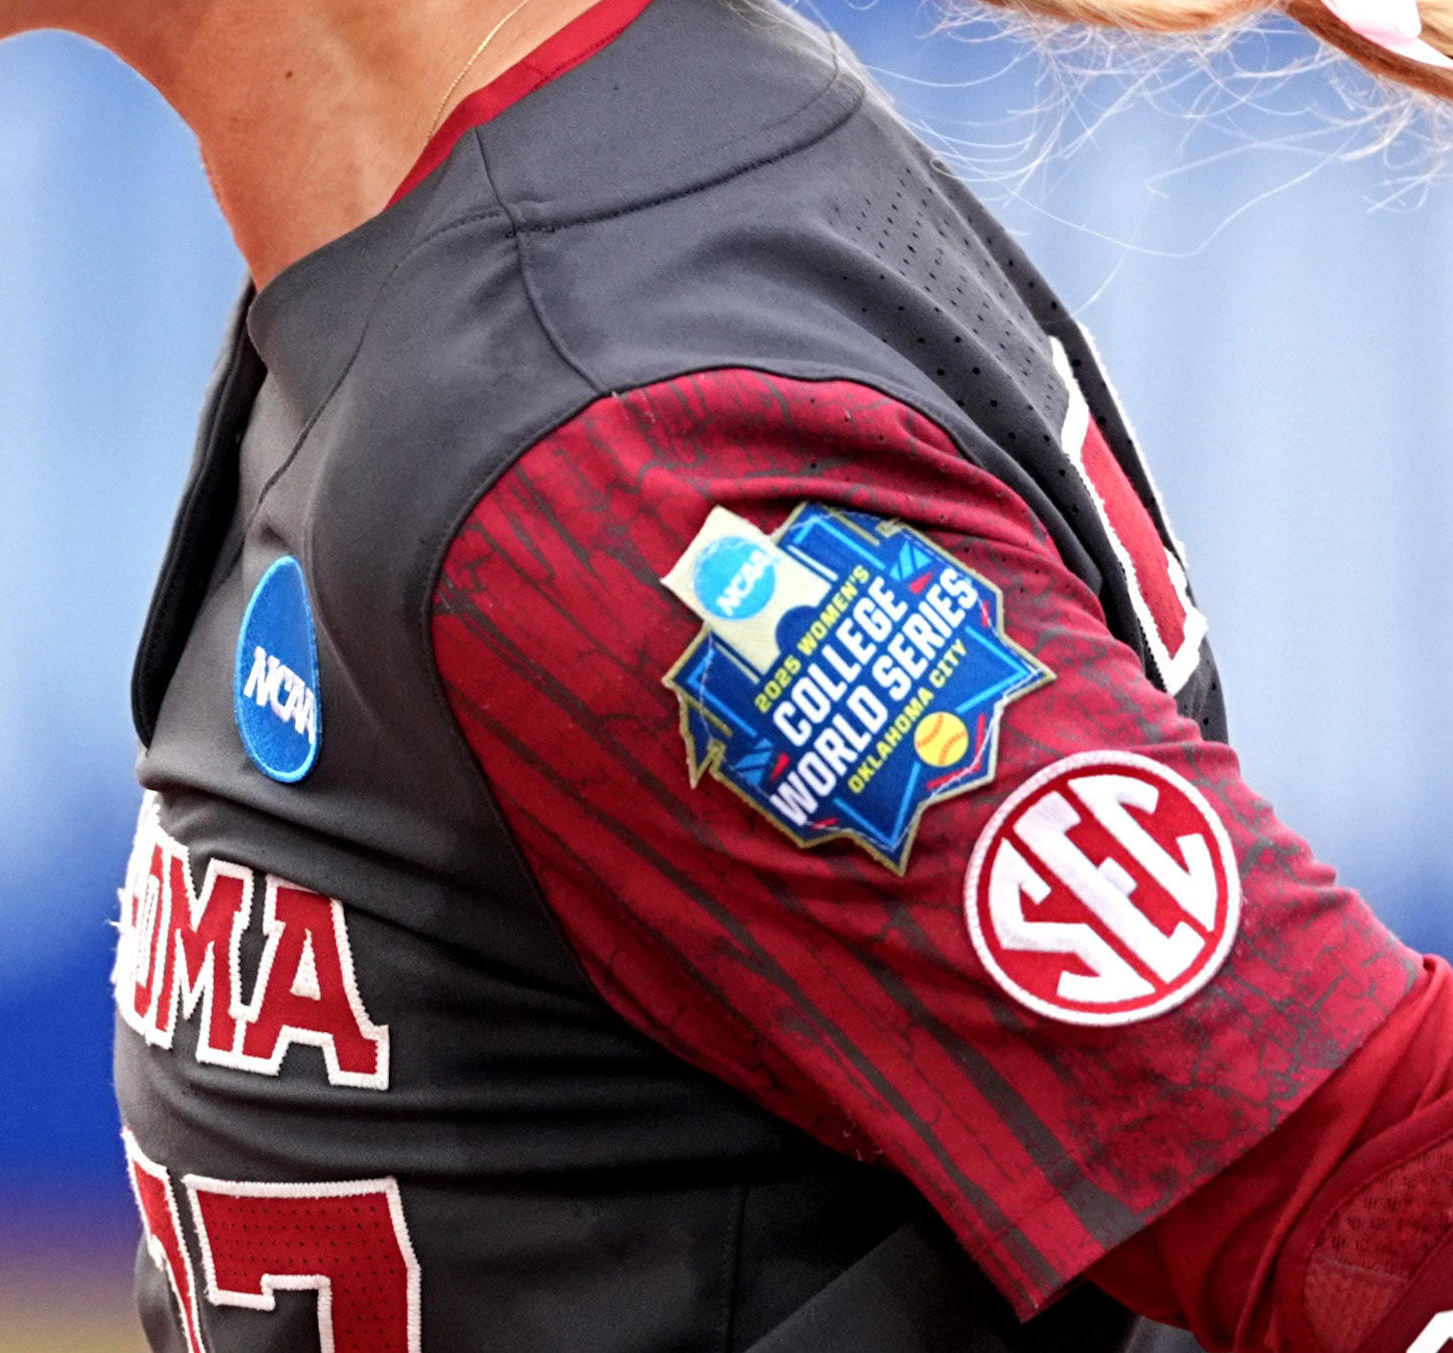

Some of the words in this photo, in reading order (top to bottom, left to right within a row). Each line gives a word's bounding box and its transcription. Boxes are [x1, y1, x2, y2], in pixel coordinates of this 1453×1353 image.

[716, 550, 774, 617] NCAA
[755, 655, 802, 714] 2025
[797, 564, 871, 657] WOMEN'S
[243, 646, 316, 745] NCAA
[769, 684, 888, 826] WORLD
[872, 567, 979, 702] SERIES
[772, 576, 909, 748] COLLEGE
[848, 686, 935, 794] OKLAHOMA
[928, 638, 968, 689] CITY
[988, 773, 1218, 1004] SEC
